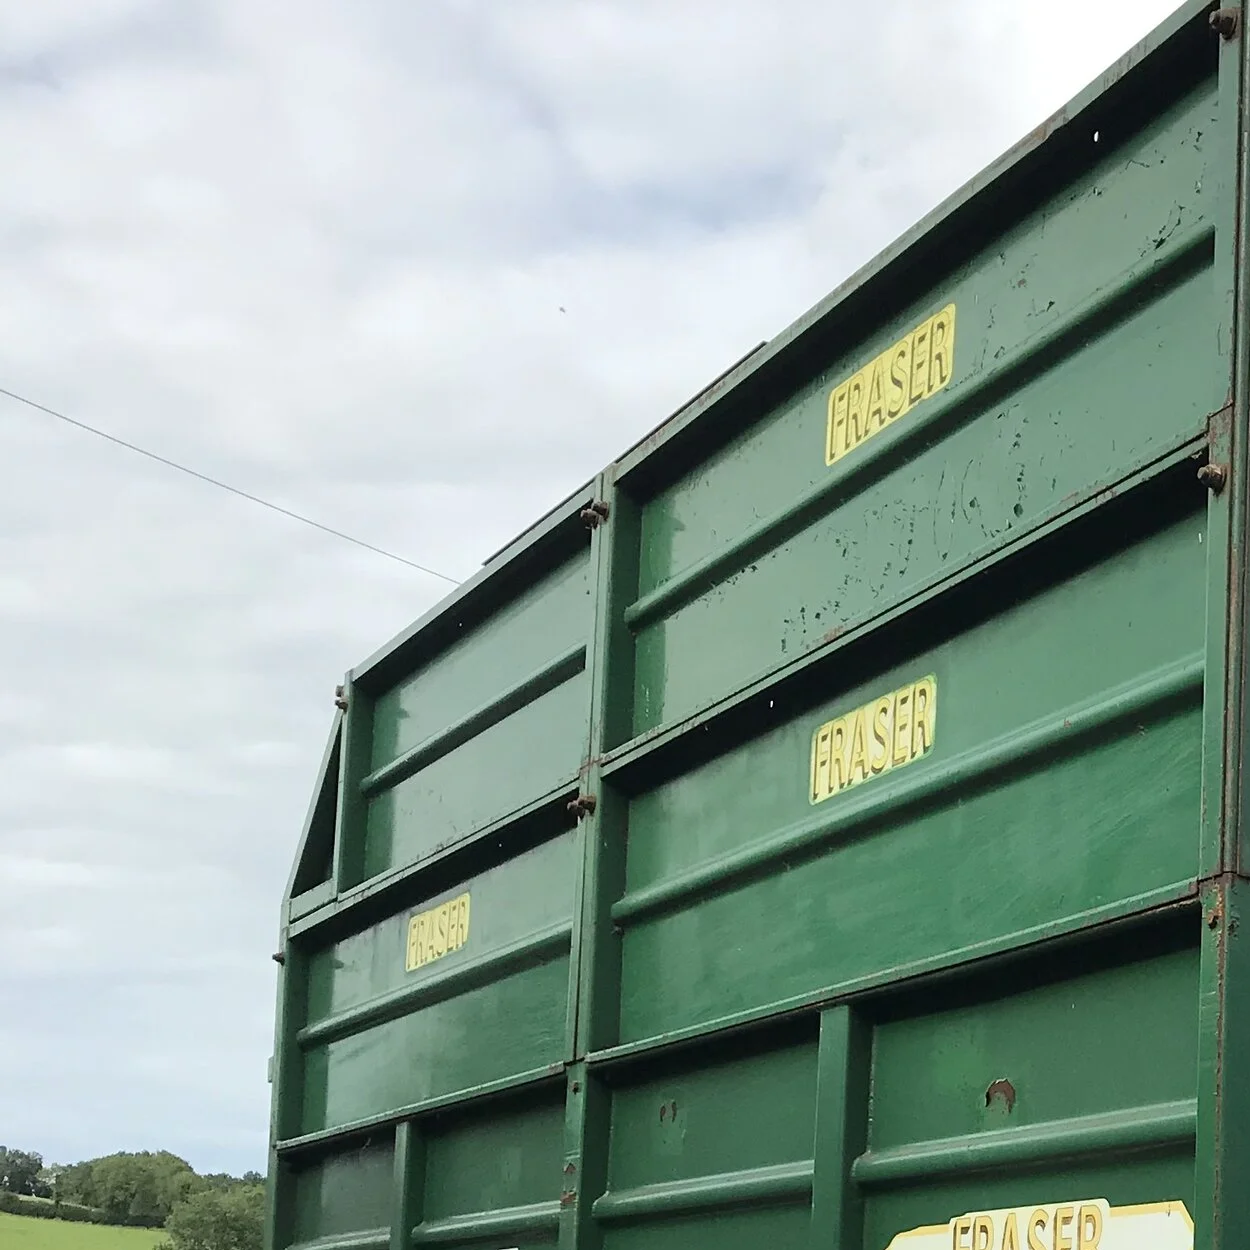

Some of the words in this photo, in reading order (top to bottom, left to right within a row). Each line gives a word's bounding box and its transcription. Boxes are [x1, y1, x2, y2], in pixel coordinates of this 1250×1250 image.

[829, 309, 951, 462] FRASER
[813, 678, 932, 801] FRASER
[407, 894, 467, 969] FRASER
